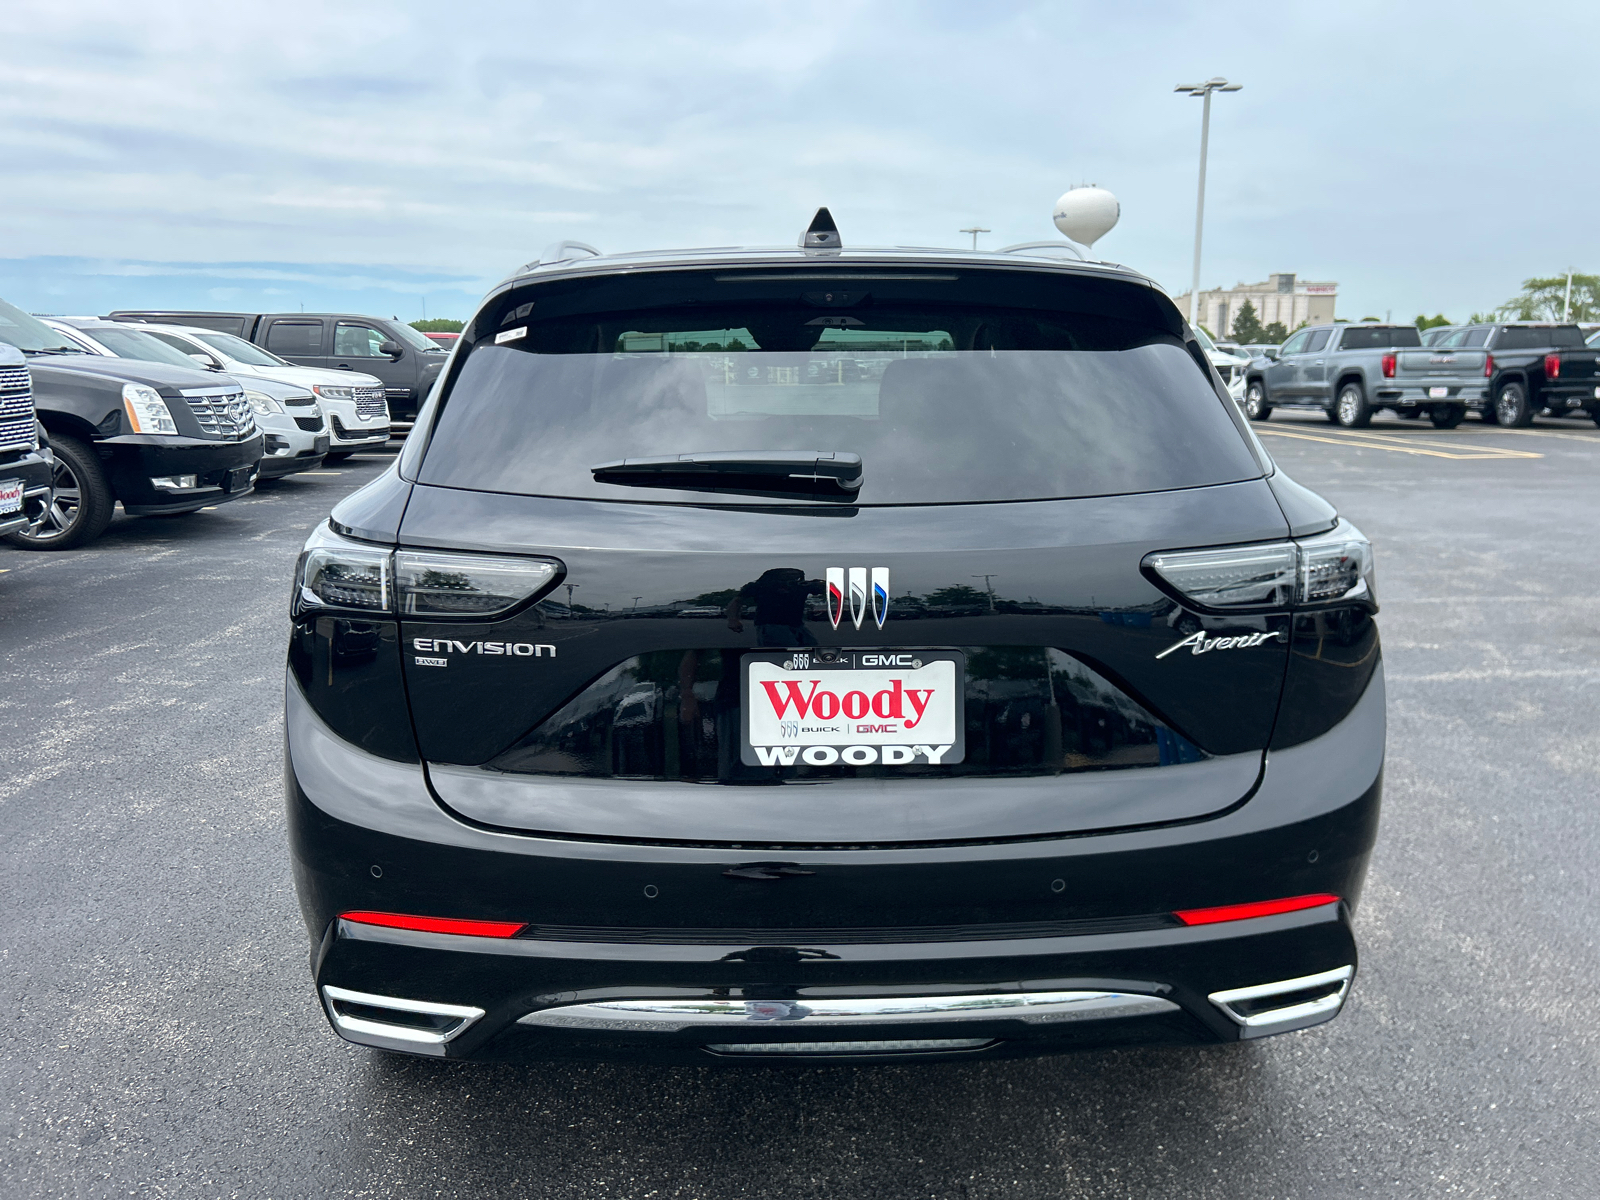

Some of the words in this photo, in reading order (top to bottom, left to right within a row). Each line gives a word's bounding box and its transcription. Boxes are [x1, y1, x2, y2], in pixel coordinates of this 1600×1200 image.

[413, 637, 557, 658] ENVISION
[1155, 630, 1280, 660] Avenir
[862, 654, 913, 666] GMC
[759, 679, 935, 729] Woody
[856, 724, 897, 734] GMC
[754, 745, 952, 766] WOODY
